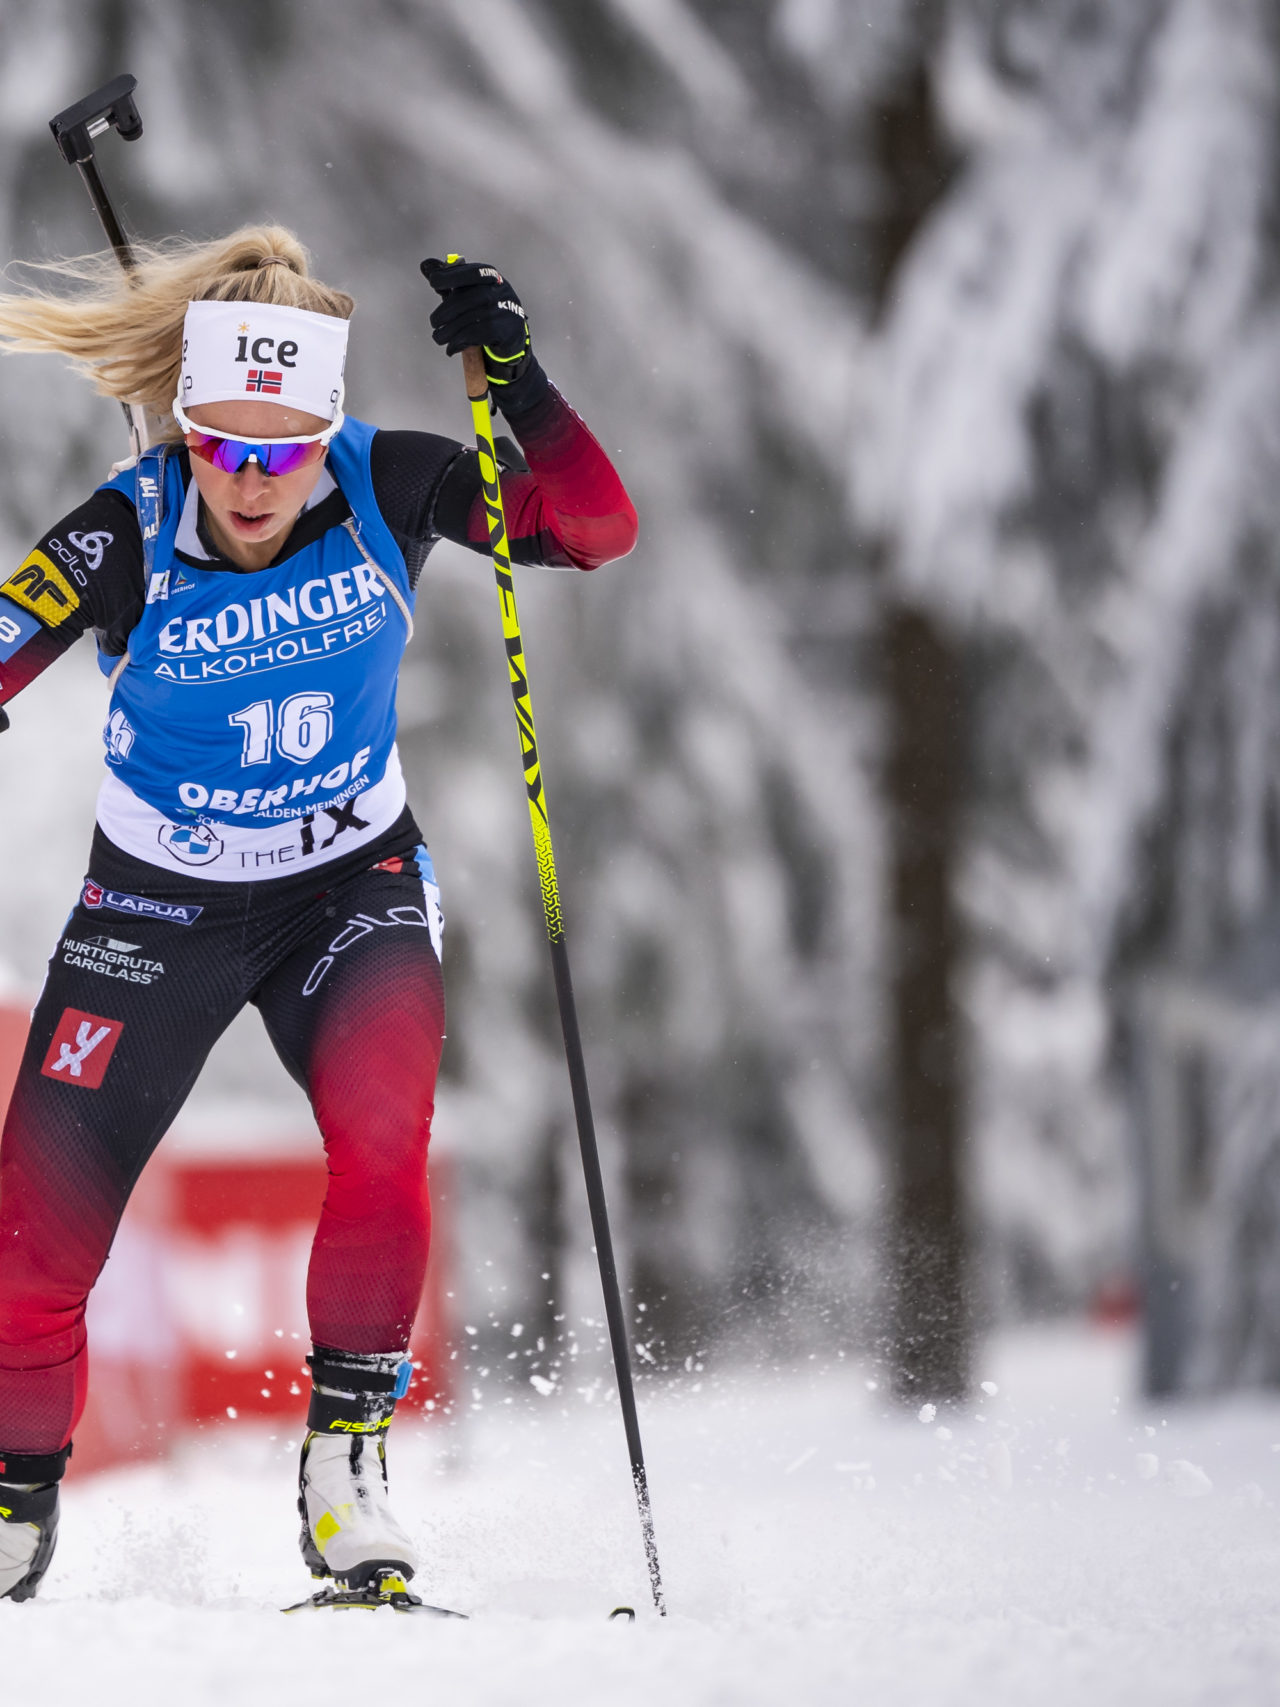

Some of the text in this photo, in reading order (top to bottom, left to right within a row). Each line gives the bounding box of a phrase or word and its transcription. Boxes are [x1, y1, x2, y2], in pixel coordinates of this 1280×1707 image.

[234, 335, 299, 368] ice
[170, 583, 196, 596] OBERHOF
[158, 562, 386, 654] ERDINGER
[153, 602, 387, 680] ALKOHOLFREI
[228, 691, 334, 768] 16
[178, 746, 371, 815] OBERHOF
[238, 845, 295, 868] THE
[106, 892, 189, 920] LAPUA
[62, 938, 165, 974] HURTIGRUTA
